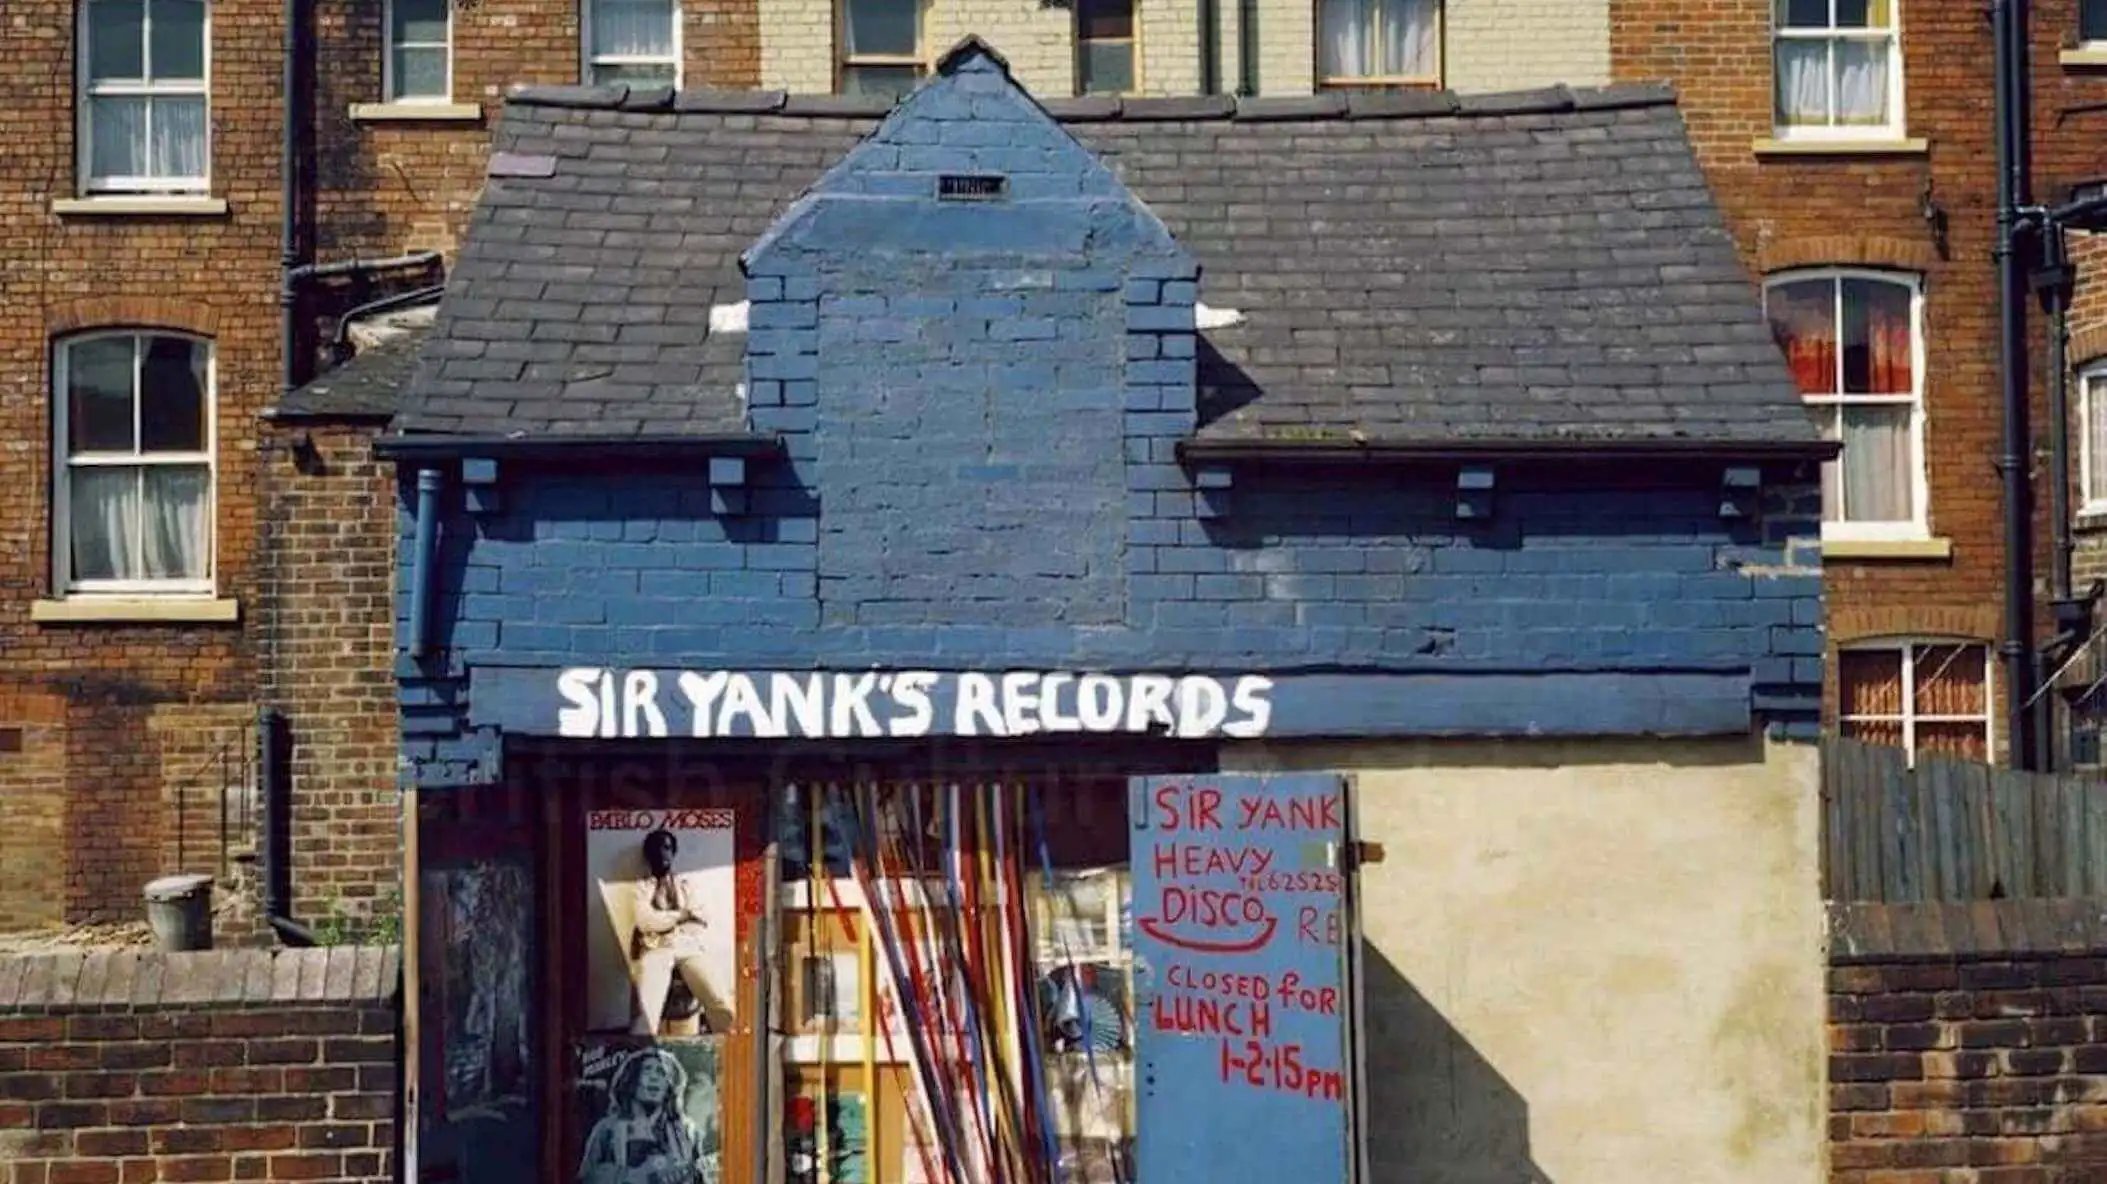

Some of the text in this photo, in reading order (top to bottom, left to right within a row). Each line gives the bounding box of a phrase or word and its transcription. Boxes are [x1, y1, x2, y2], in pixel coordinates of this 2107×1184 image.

[558, 667, 1274, 738] SIR YANK'S RECORDS
[658, 811, 732, 829] MOSES
[1237, 795, 1341, 830] YANK
[1154, 843, 1275, 878] HEAVY
[1168, 965, 1270, 1001] CLOSED
[1154, 996, 1271, 1037] LUNCH
